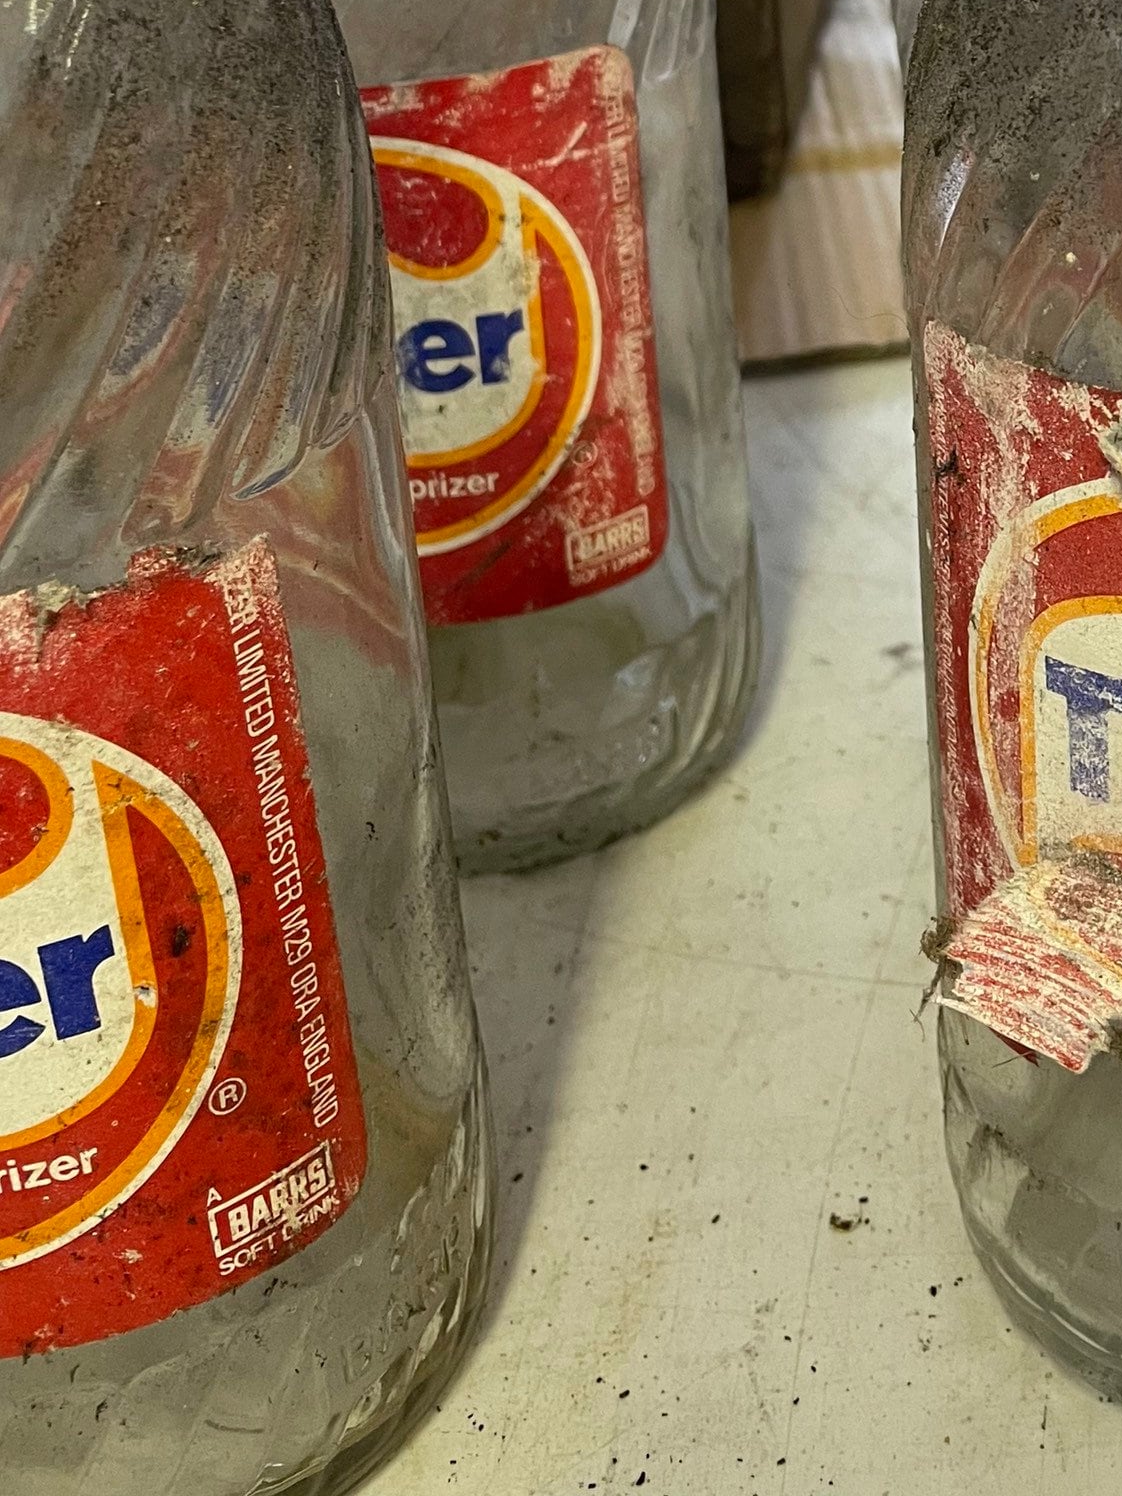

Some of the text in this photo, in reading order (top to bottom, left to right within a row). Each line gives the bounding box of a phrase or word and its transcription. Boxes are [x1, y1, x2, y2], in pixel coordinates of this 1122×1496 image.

[397, 308, 524, 392] er
[233, 628, 275, 737] LIMITED
[251, 734, 303, 911] MANCHESTER
[280, 904, 312, 966] M29
[300, 1013, 339, 1129] ENGLAND
[206, 1187, 222, 1207] A
[227, 1157, 327, 1242] BARRS
[219, 1231, 277, 1276] SOFT
